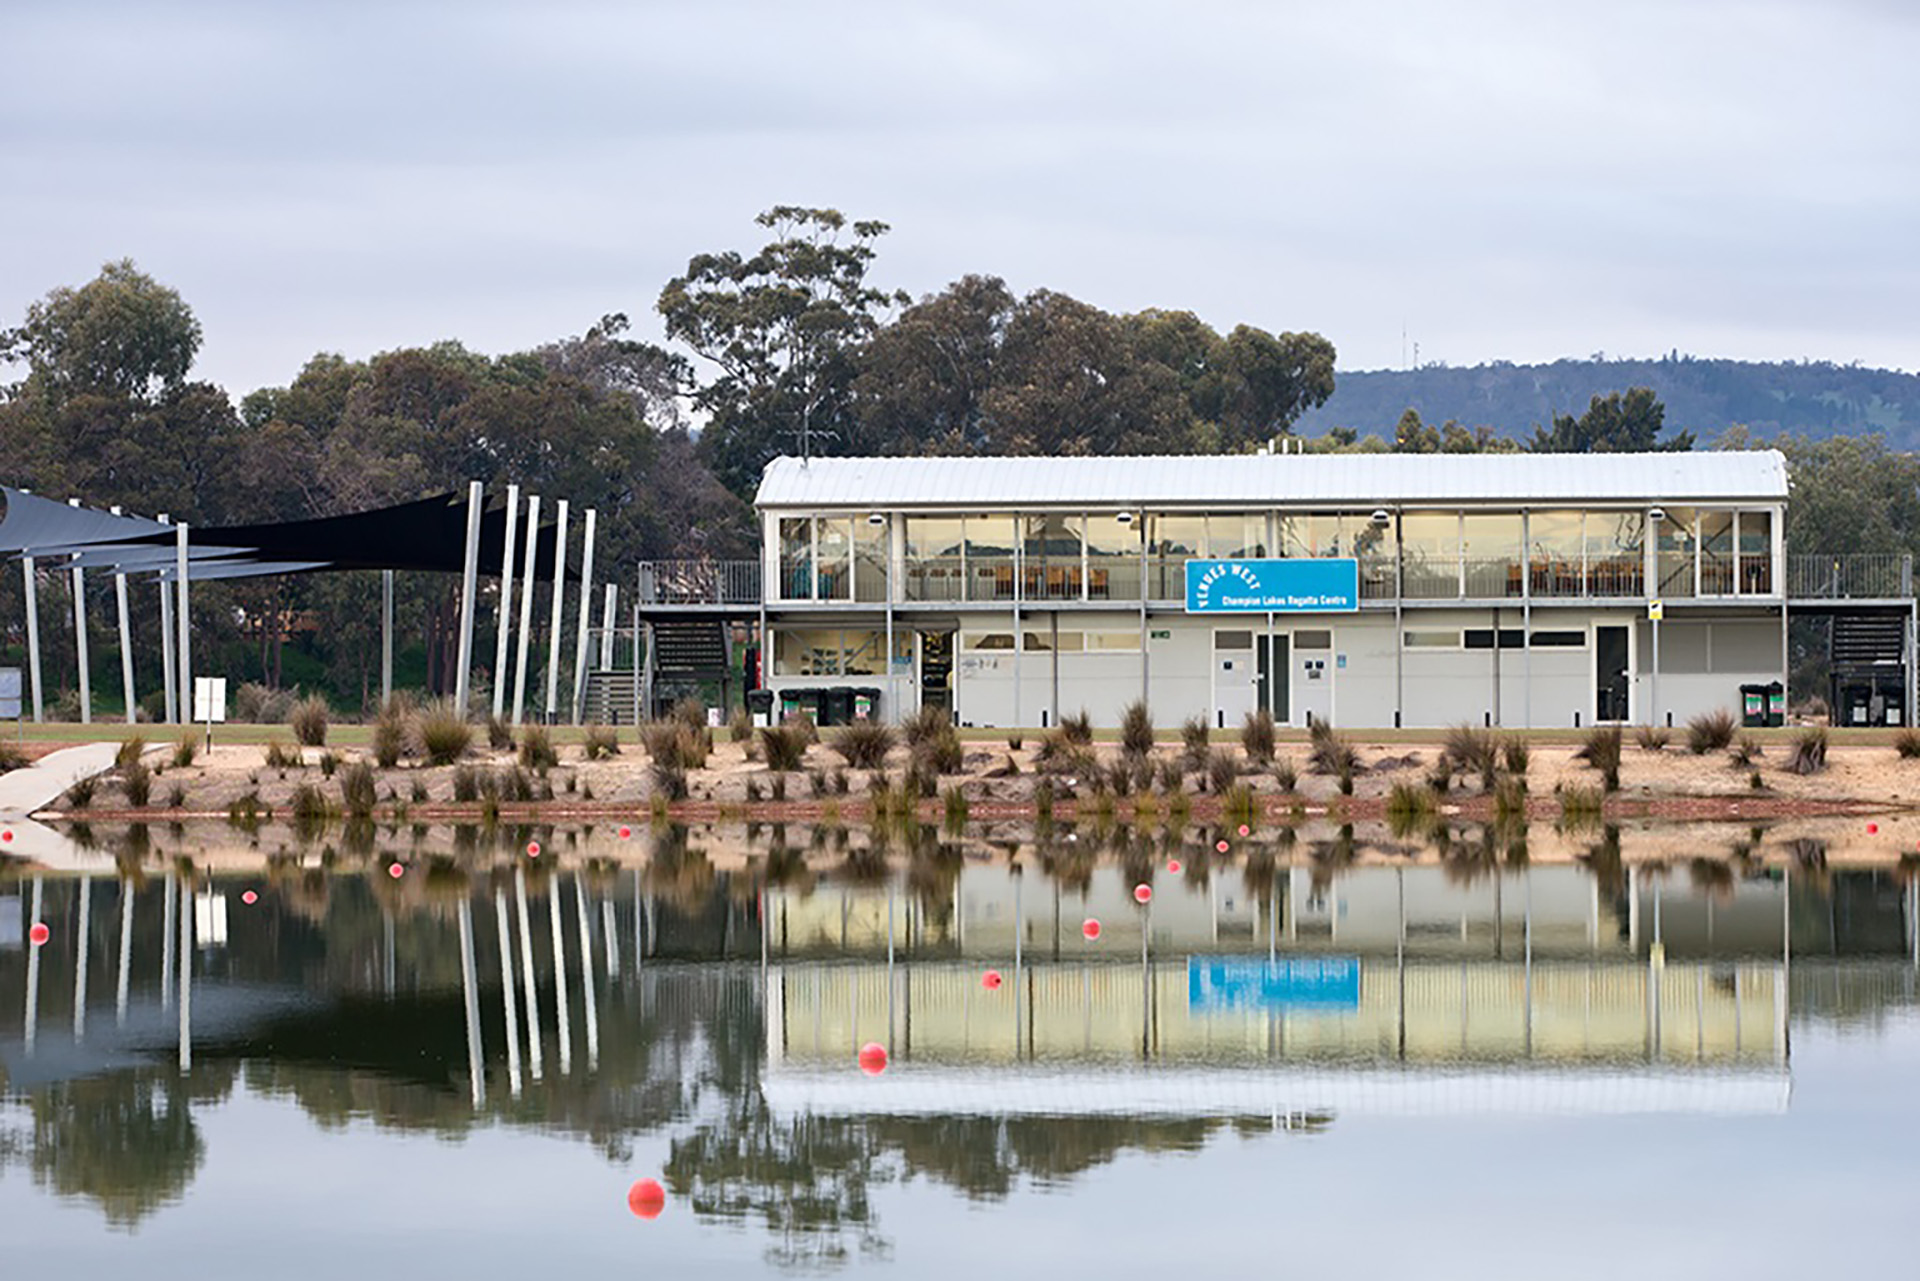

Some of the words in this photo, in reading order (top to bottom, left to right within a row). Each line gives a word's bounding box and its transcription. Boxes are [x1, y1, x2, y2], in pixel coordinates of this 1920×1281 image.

[1196, 564, 1226, 608] VENUES
[1231, 564, 1261, 589] WEST
[1222, 595, 1261, 607] Champion
[1262, 595, 1286, 606] Lakes
[1287, 594, 1319, 607] Regatta
[1320, 594, 1347, 605] Centre
